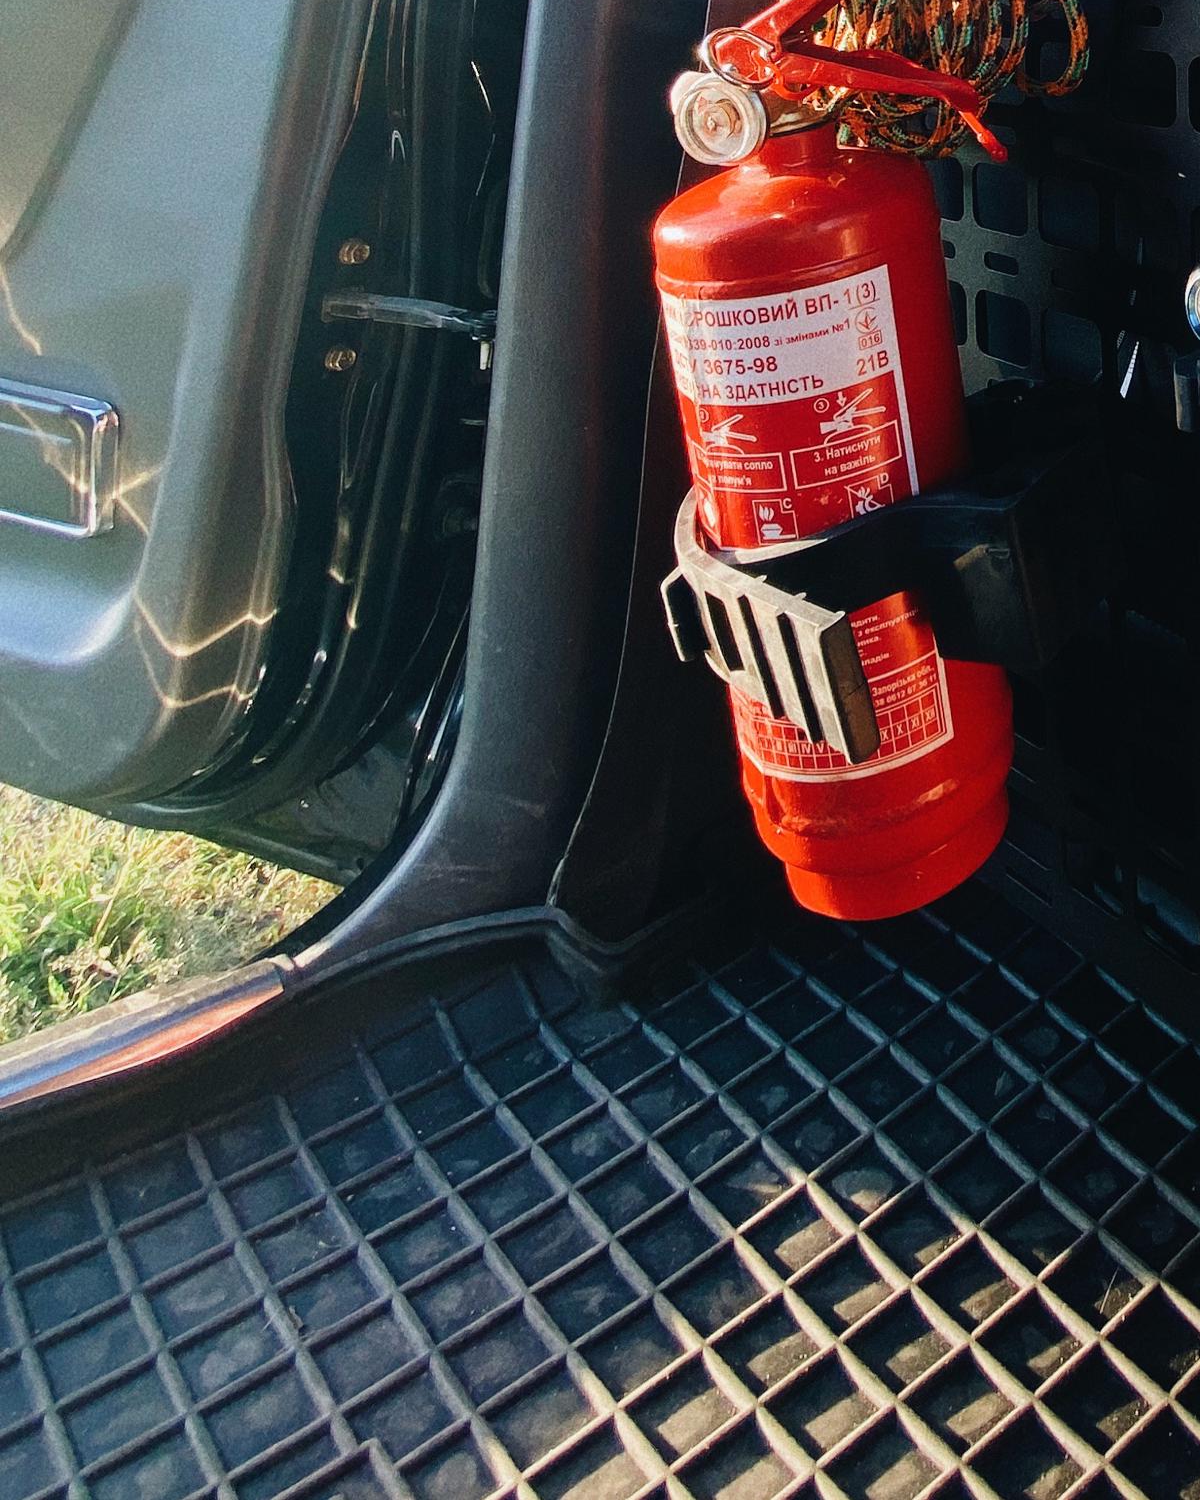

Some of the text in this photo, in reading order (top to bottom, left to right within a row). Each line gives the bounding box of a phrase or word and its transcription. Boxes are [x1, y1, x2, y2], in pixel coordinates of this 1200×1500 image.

[861, 333, 880, 348] 016
[703, 356, 778, 375] 3675-98
[725, 375, 824, 402] ЗДАТНІСТЬ
[826, 435, 881, 460] Натиснути
[744, 460, 773, 470] сопло
[824, 454, 875, 476] на важіль
[879, 472, 889, 485] D
